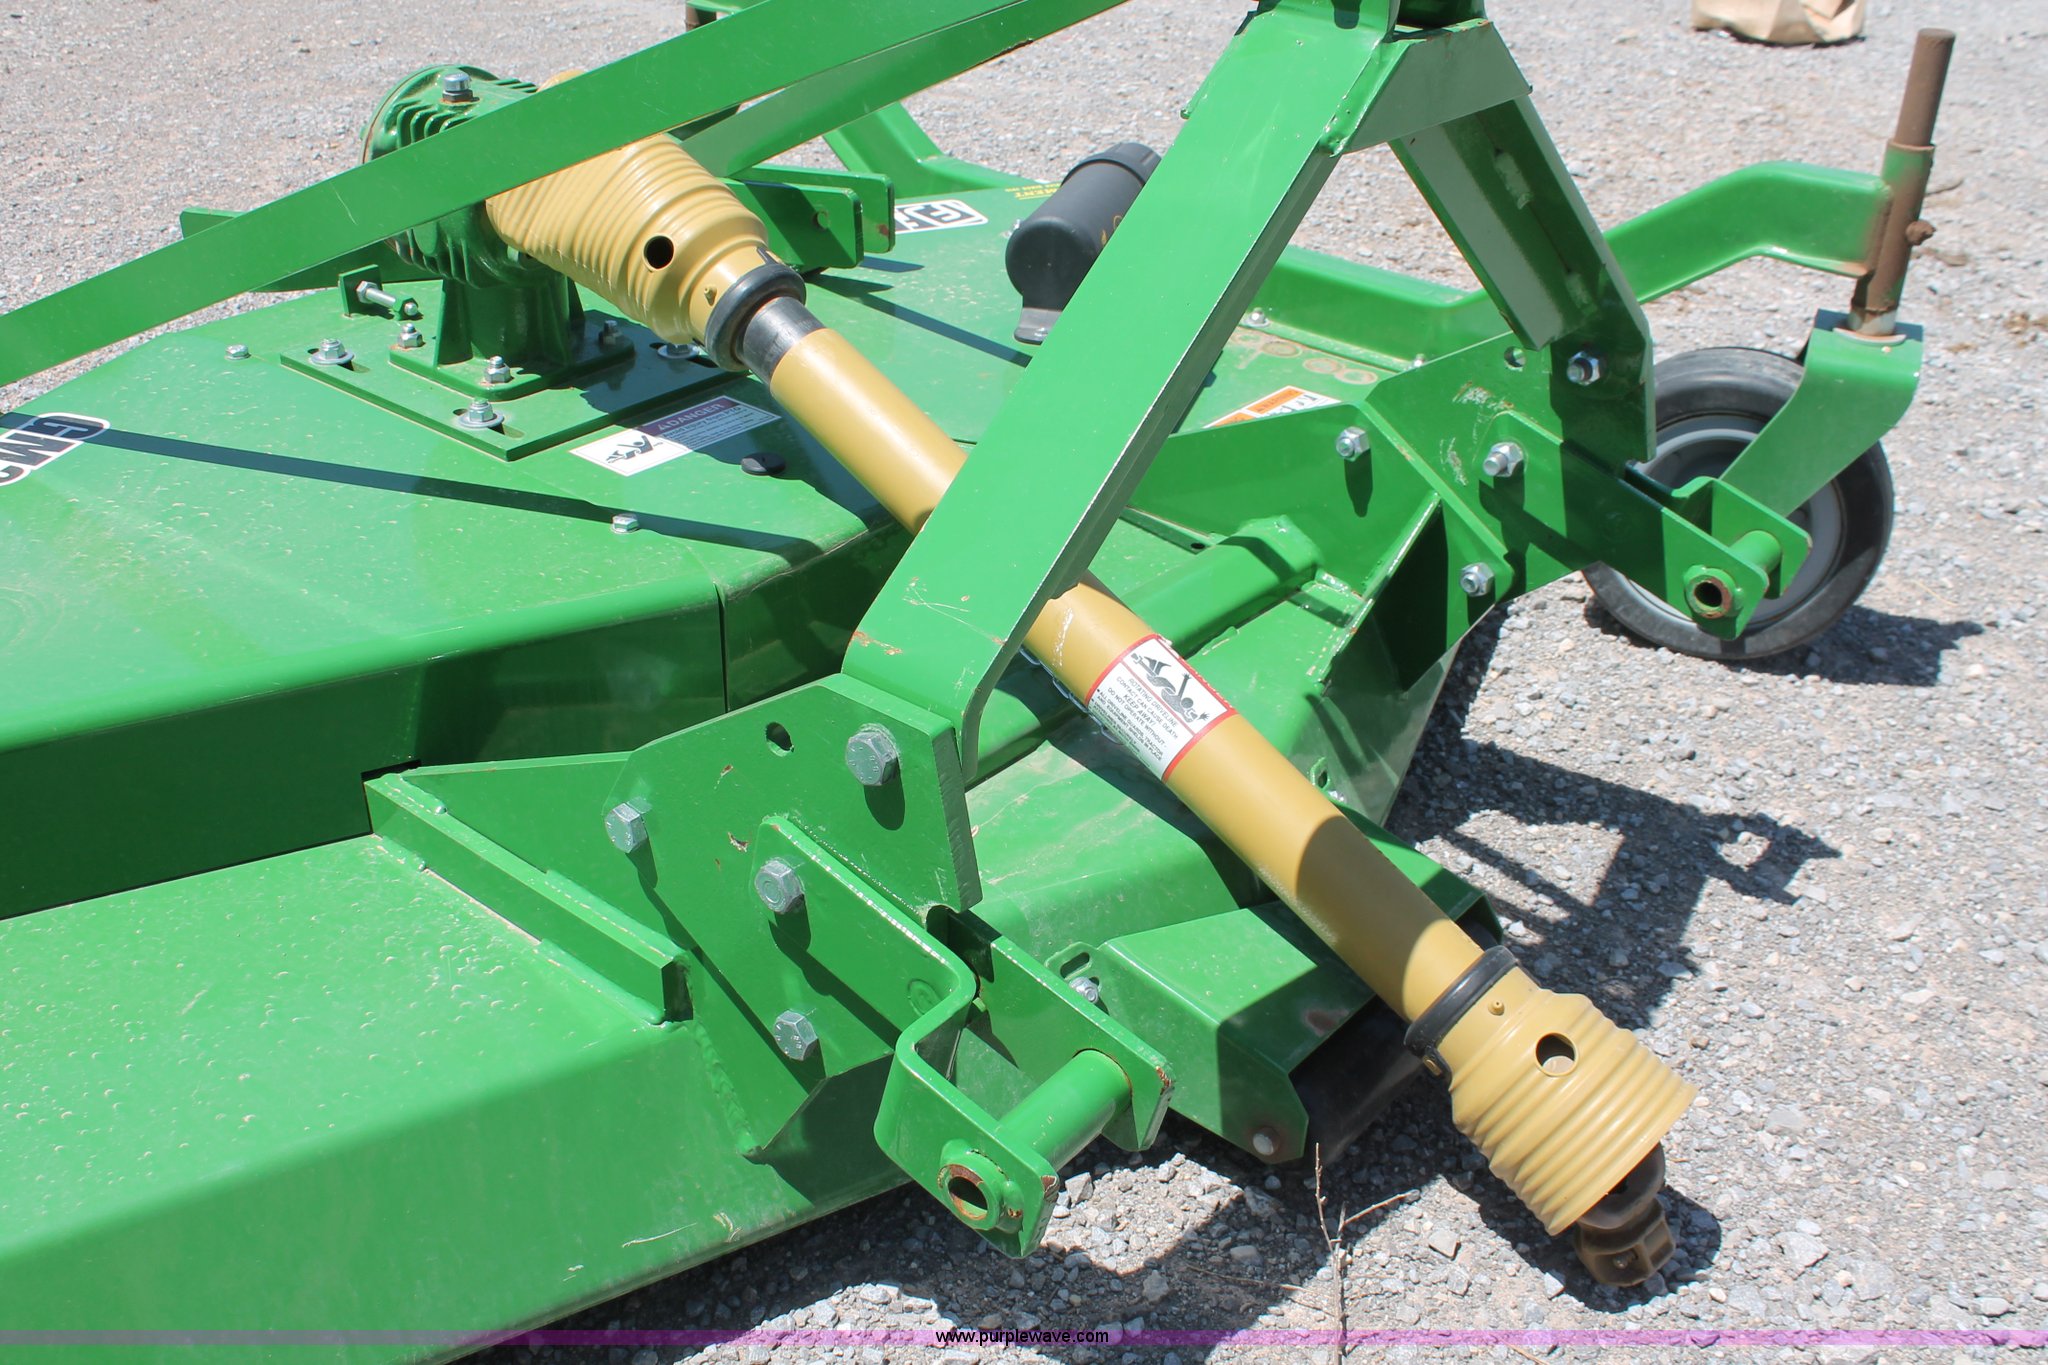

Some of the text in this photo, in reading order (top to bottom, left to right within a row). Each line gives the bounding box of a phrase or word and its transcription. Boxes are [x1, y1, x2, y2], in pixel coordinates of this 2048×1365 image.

[667, 403, 725, 427] DANGER
[1096, 695, 1106, 705] AND
[1106, 705, 1128, 727] EQUIPMENT
[1128, 726, 1144, 743] SHIELDS
[1148, 747, 1162, 761] PLACE
[1098, 691, 1107, 699] ALL
[1106, 698, 1127, 720] DRIVELINE
[1144, 736, 1163, 755] TRACTOR
[1107, 687, 1115, 696] DO
[1114, 694, 1124, 705] NOT
[1123, 704, 1144, 726] OPERATE
[1144, 724, 1165, 745] WITHOUT
[1116, 676, 1178, 738] CONTACT CAN CAUSE DEATH
[1122, 694, 1156, 726] KEEP AWAY!
[1128, 677, 1177, 727] ROTATING DRIVELINE
